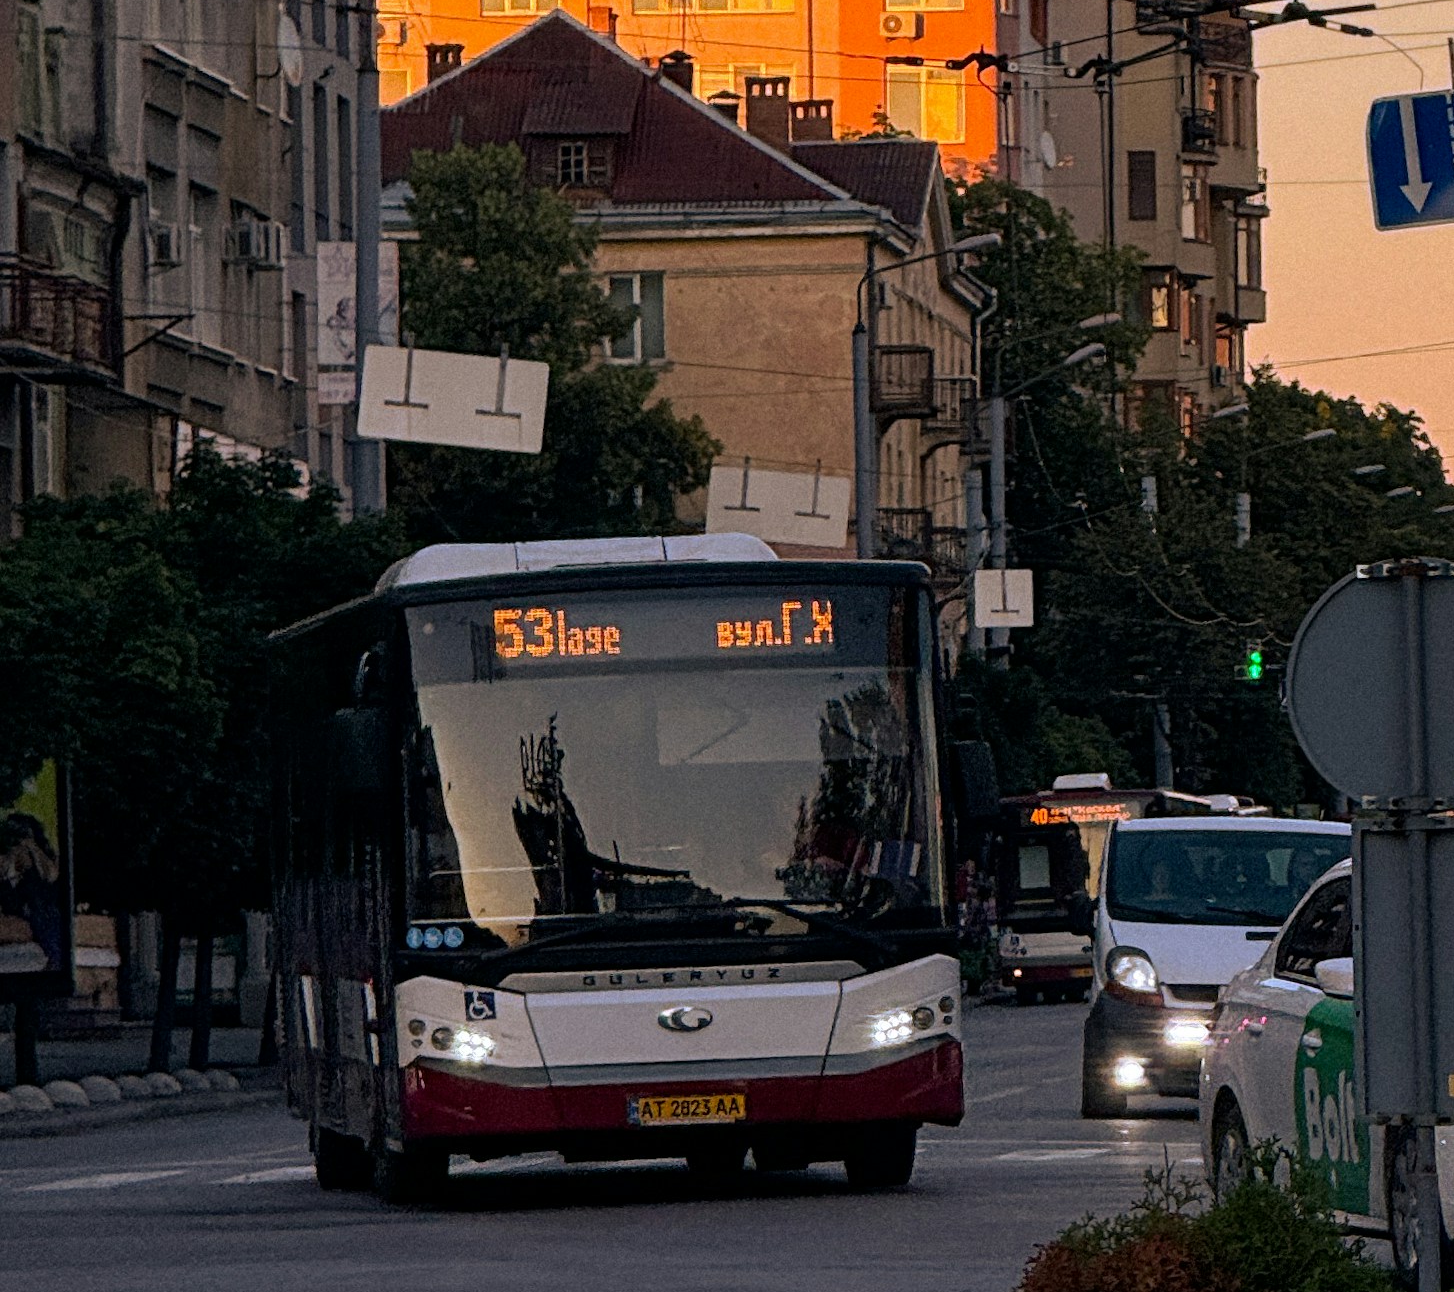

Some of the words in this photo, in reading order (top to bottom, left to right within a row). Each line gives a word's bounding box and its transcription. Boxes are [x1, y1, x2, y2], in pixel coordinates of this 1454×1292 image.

[1030, 808, 1049, 825] 40
[641, 1100, 666, 1119] AT
[671, 1098, 712, 1117] 2823
[716, 1097, 741, 1116] AA
